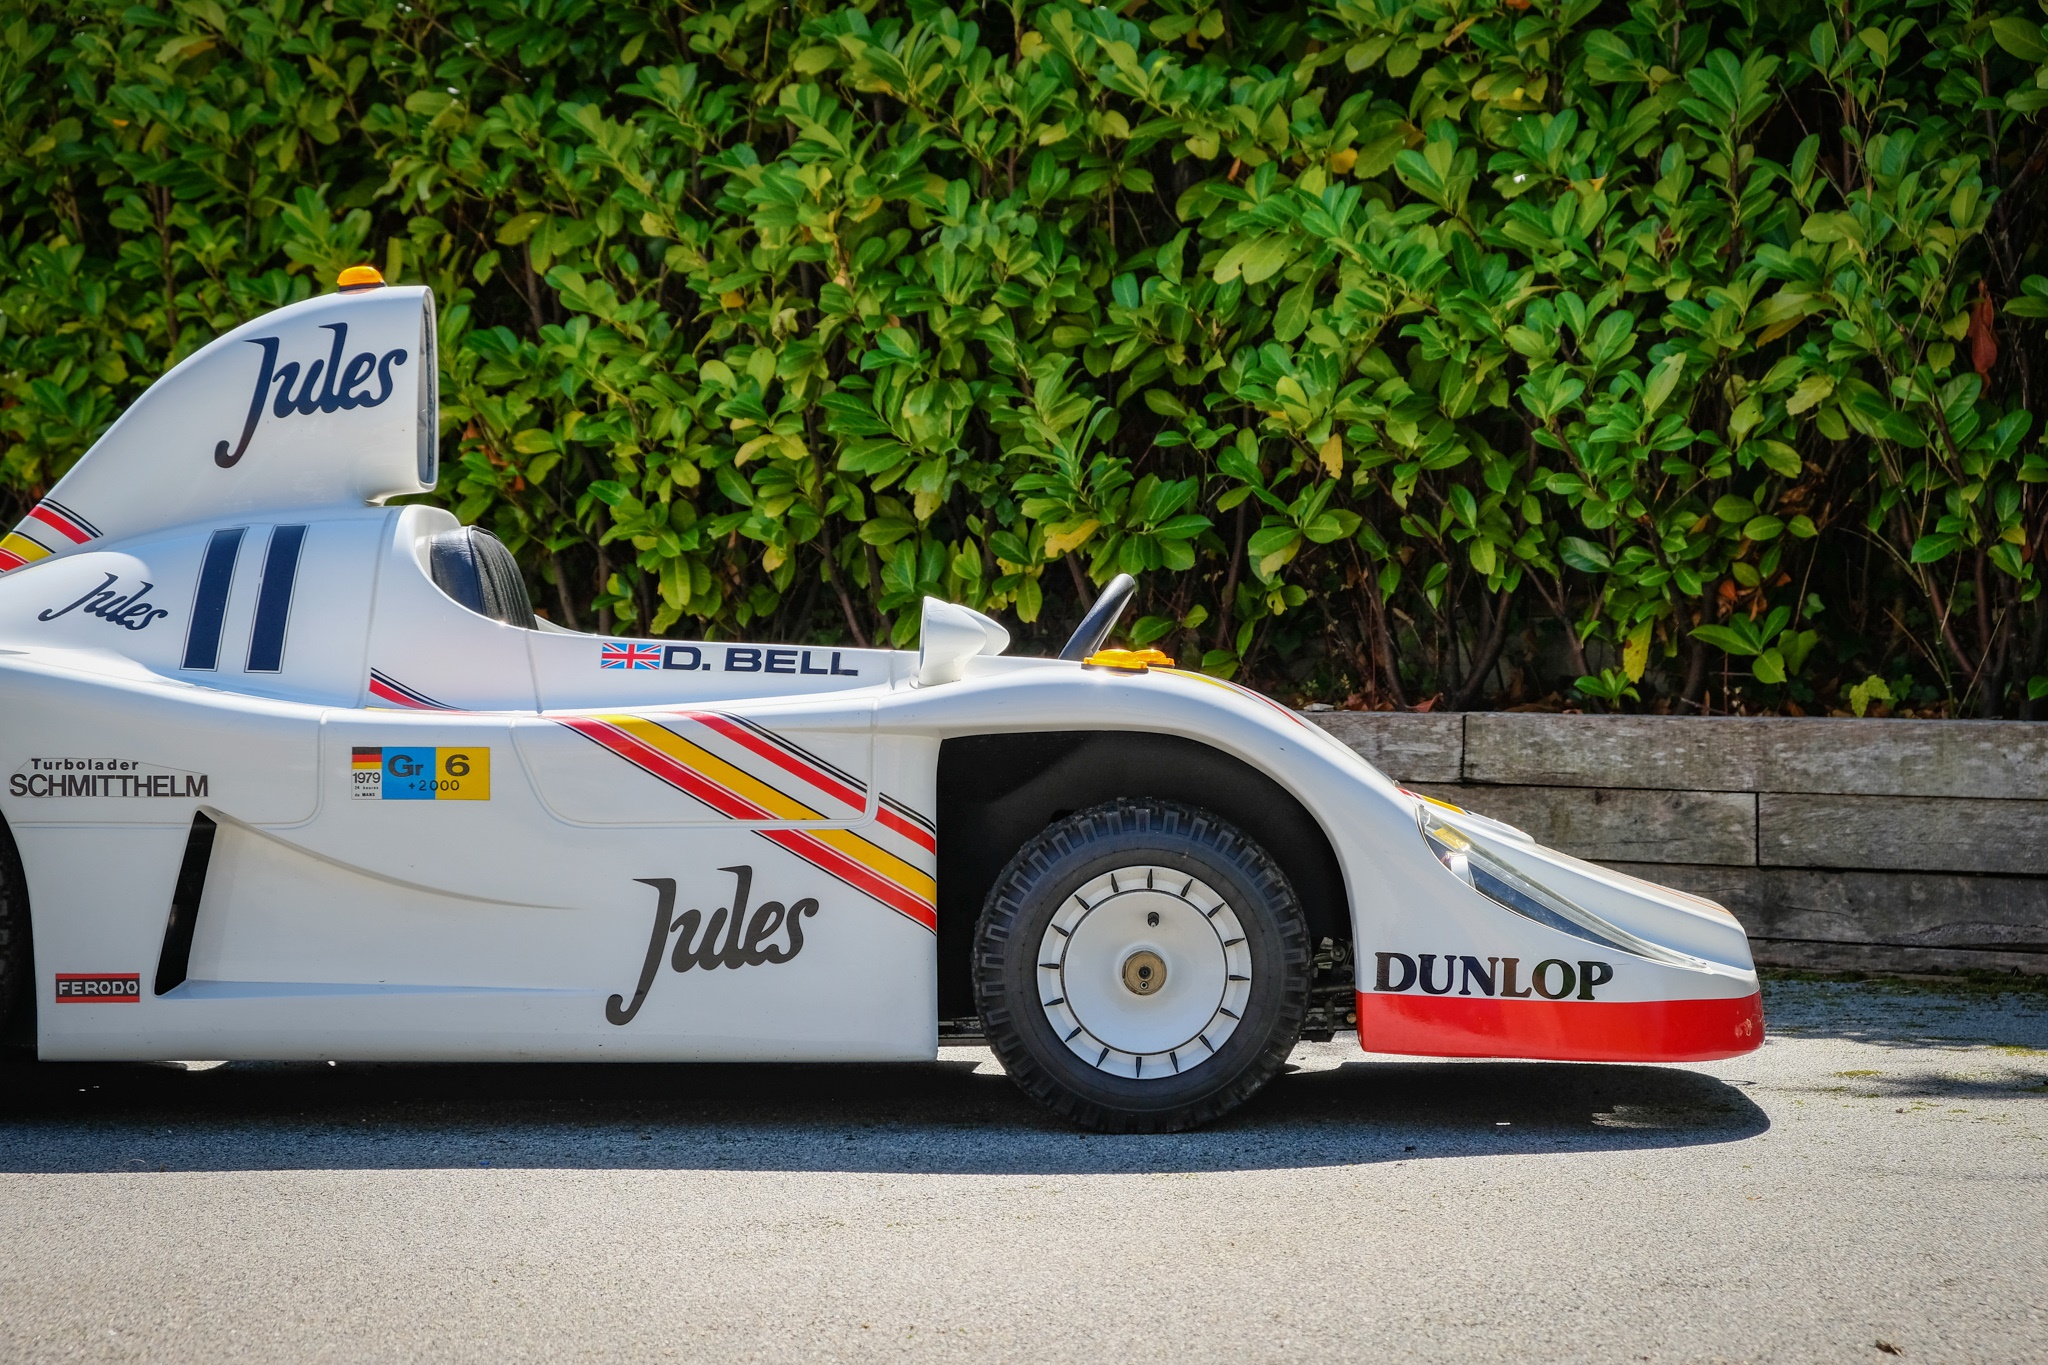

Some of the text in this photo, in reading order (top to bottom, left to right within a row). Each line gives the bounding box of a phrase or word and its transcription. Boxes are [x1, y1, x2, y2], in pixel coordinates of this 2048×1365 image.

[214, 322, 408, 469] Jules
[38, 572, 168, 631] Jules
[662, 645, 859, 677] D. BELL
[31, 758, 139, 771] Turbolader
[352, 772, 381, 784] 1979
[387, 754, 470, 777] Gr 6
[9, 773, 209, 798] SCHMITTHELM
[605, 865, 820, 1026] Jules
[58, 980, 139, 995] FERODO
[1373, 952, 1614, 1001] DUNLOP
